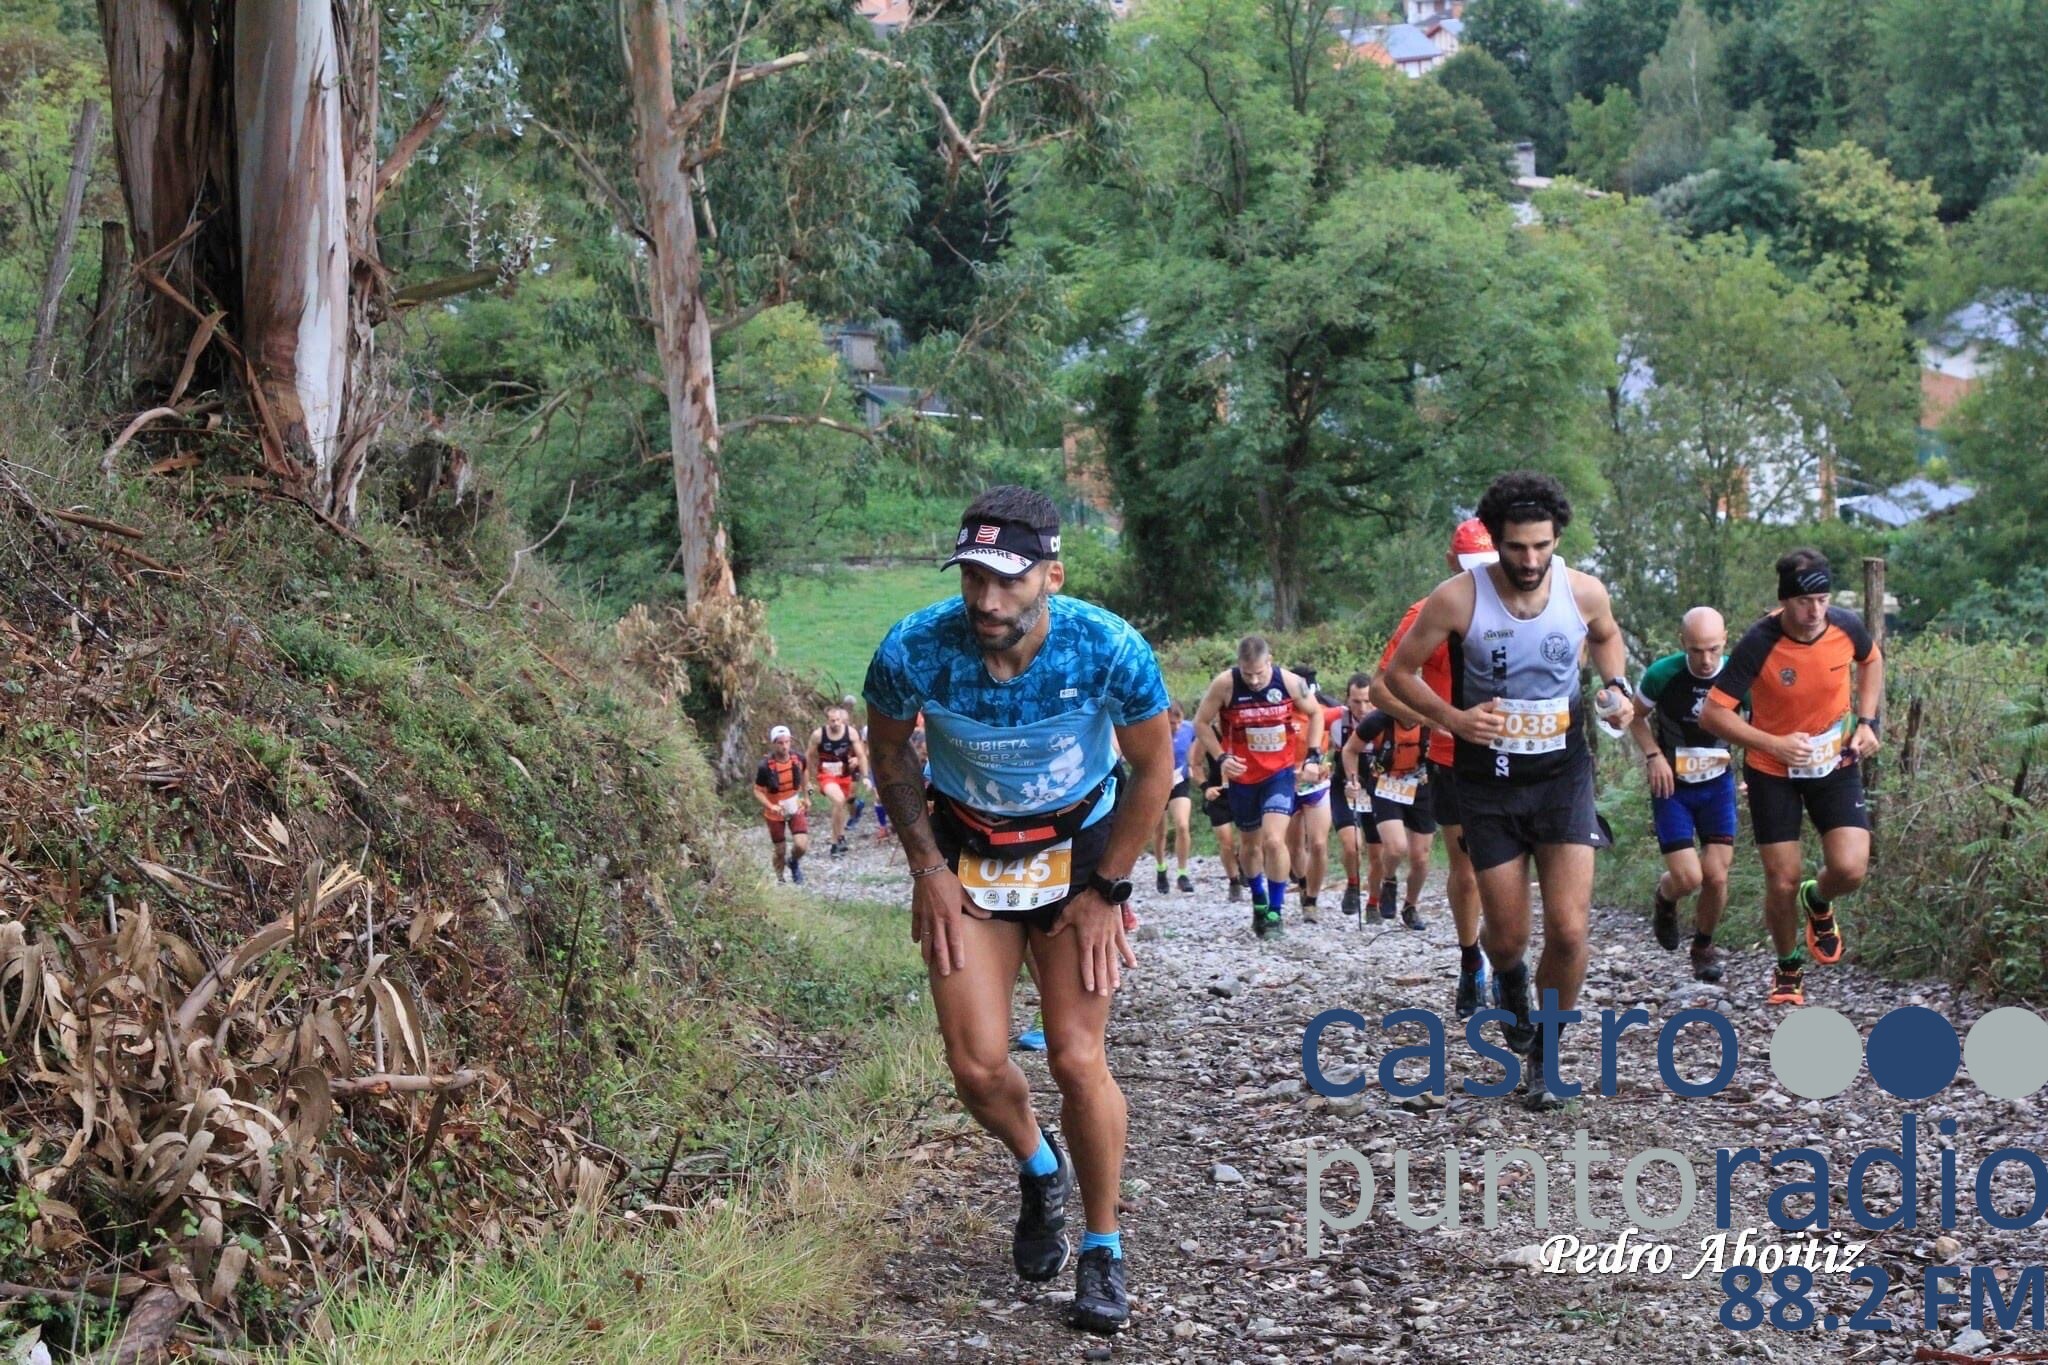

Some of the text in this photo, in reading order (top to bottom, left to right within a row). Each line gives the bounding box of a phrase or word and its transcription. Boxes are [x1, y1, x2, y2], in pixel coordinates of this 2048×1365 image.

[1505, 713, 1558, 736] 038
[968, 738, 1030, 752] UBIETA
[980, 852, 1052, 883] 045
